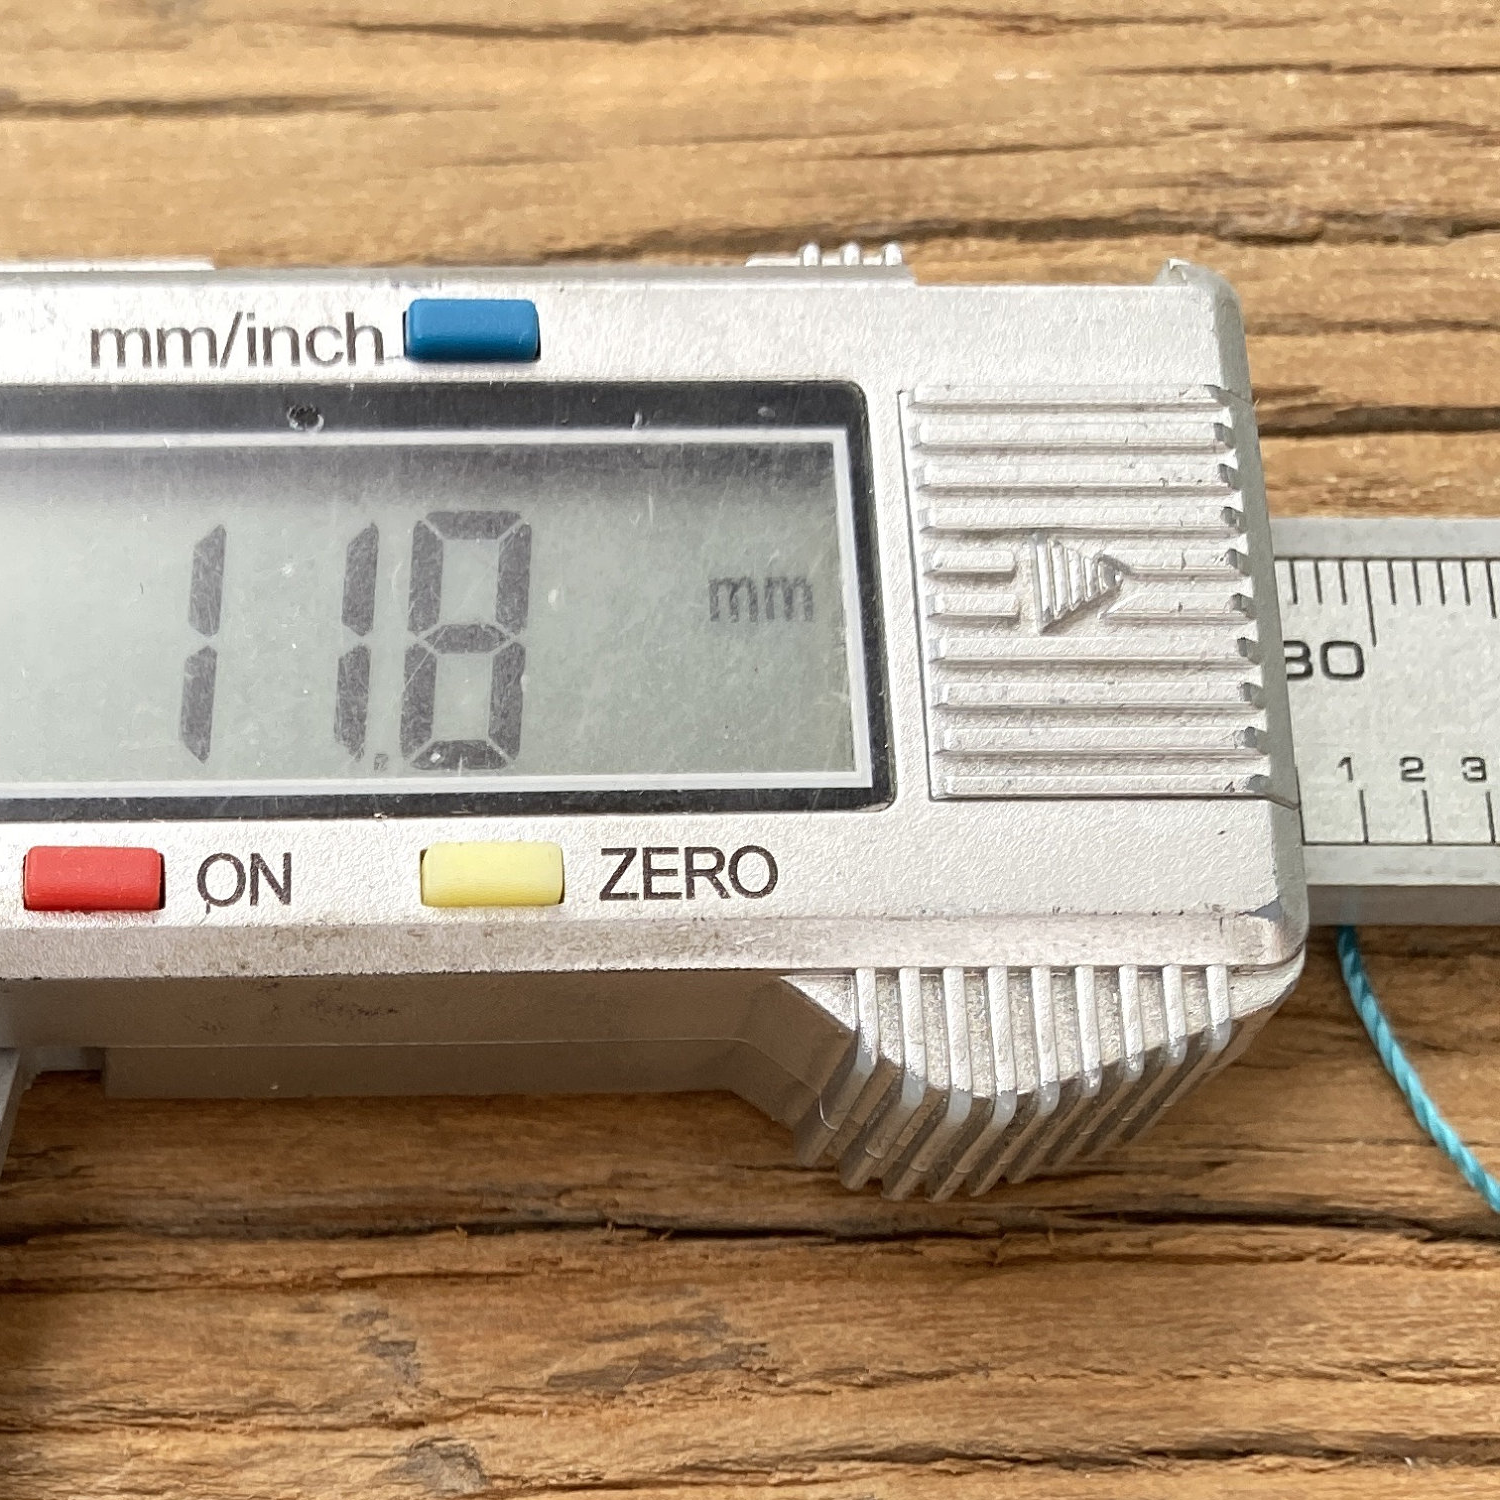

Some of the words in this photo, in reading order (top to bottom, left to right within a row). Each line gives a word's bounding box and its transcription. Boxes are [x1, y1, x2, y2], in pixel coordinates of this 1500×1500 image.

[90, 312, 384, 369] mm/inch
[709, 574, 814, 623] mm
[1337, 756, 1354, 782] 1
[1399, 756, 1426, 782] 2
[1460, 756, 1487, 782] 3
[197, 851, 293, 906] ON
[599, 844, 779, 902] ZERO
